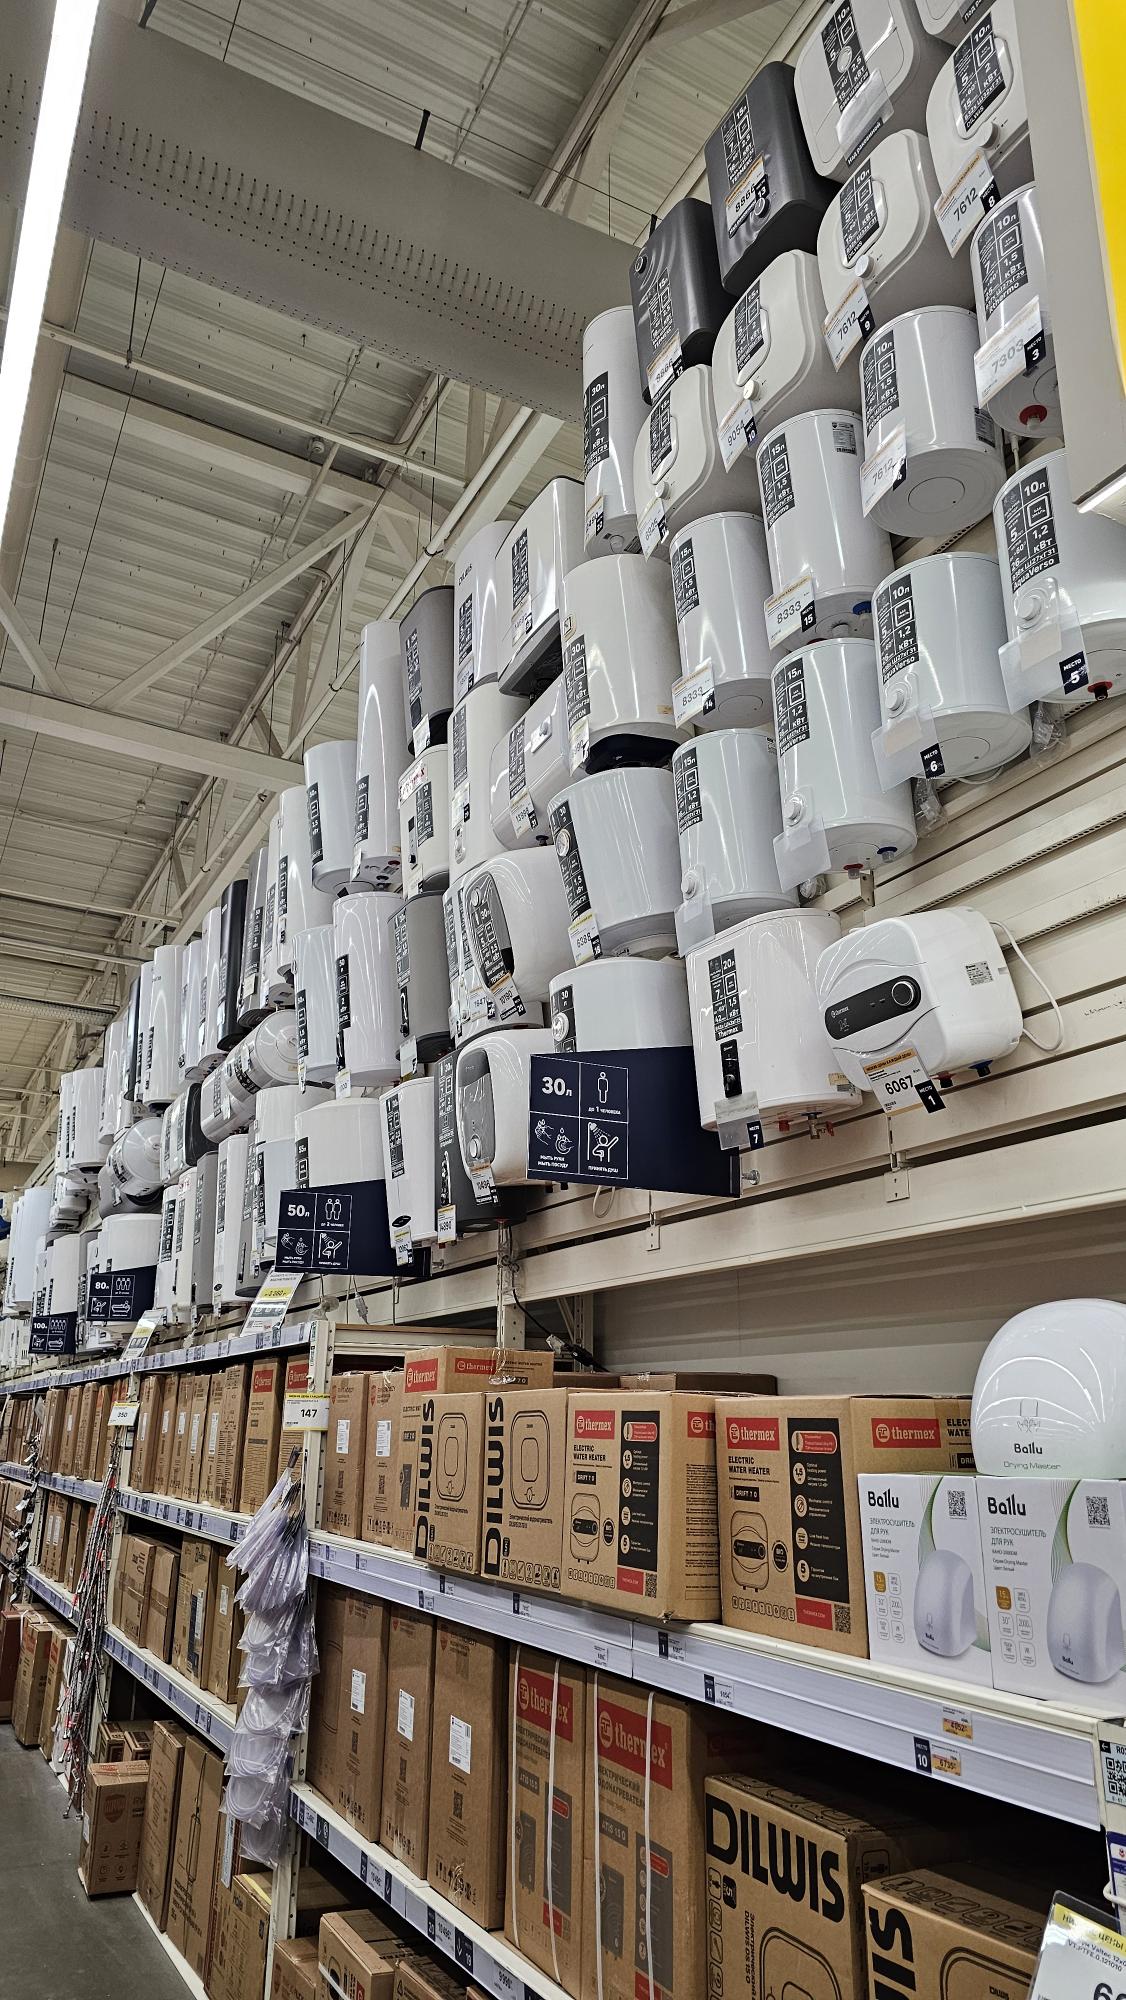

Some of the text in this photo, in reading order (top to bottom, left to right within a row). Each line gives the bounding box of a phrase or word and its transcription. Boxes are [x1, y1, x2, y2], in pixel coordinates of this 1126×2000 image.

[973, 24, 990, 42] 10л
[985, 62, 991, 73] 2
[961, 73, 968, 86] 5
[857, 169, 870, 185] 10л
[757, 187, 767, 199] 13
[953, 187, 978, 221] 7612
[988, 195, 995, 208] 8
[996, 213, 1017, 231] 10л
[1004, 251, 1018, 266] 1,5
[837, 311, 859, 341] 7612
[864, 321, 871, 331] 9
[876, 340, 893, 356] 10л
[1032, 348, 1040, 361] 3
[591, 383, 605, 397] 30л
[880, 377, 893, 390] 1,5
[595, 427, 601, 437] 2
[771, 443, 785, 454] 15л
[872, 458, 893, 486] 7612
[777, 479, 787, 490] 1,5
[1024, 481, 1046, 496] 10л
[1010, 529, 1018, 542] 5
[1033, 525, 1049, 540] 1,2
[1033, 538, 1053, 553] кВт
[680, 547, 692, 559] 15л
[1013, 557, 1055, 590] AquaVerso
[893, 586, 909, 600] 10л
[777, 601, 801, 624] 8333
[804, 615, 813, 626] 15
[898, 625, 912, 638] 1,2
[571, 644, 585, 656] 30л
[898, 639, 914, 651] кВт
[1063, 659, 1082, 671] МЕСТО
[787, 668, 802, 680] 15л
[1070, 670, 1080, 684] 5
[791, 705, 803, 717] 1,2
[792, 716, 806, 728] кВт
[683, 756, 696, 768] 15л
[930, 760, 938, 772] 6
[723, 959, 735, 970] 20л
[541, 1076, 573, 1097] 30л
[885, 1075, 913, 1095] 6067
[928, 1095, 936, 1106] 1
[753, 1134, 759, 1144] 7
[287, 1204, 310, 1217] 50л
[95, 1282, 109, 1290] 80л
[413, 1370, 436, 1384] thermex
[301, 1409, 318, 1418] 147
[585, 1418, 612, 1431] thermex
[946, 1419, 971, 1427] ELECT
[741, 1427, 775, 1441] thermex
[889, 1428, 935, 1440] thermex
[947, 1430, 971, 1438] WATE
[1014, 1442, 1043, 1455] Ballu
[573, 1453, 606, 1462] WATER HEATER
[728, 1456, 754, 1464] ELECTRIC
[728, 1466, 770, 1475] WATER HEATER
[1003, 1461, 1061, 1470] Drying Master
[415, 1399, 435, 1559] DILWIS
[484, 1396, 504, 1576] DILWIS
[735, 1489, 748, 1497] DRIFT
[868, 1488, 899, 1508] Ballu
[987, 1494, 1027, 1516] Ballu
[869, 1517, 916, 1529] ЭЛЕКТРОСУШИТЕЛЬ
[990, 1526, 1046, 1538] ЭЛЕКТРОСУШИТЕЛЬ
[623, 1537, 628, 1546] 5
[991, 1538, 1014, 1546] ДЛЯ РУК
[800, 1563, 806, 1573] 5
[917, 1753, 928, 1768] 10
[706, 1793, 845, 1923] DILWIS
[1091, 1945, 1112, 1959] Valtec
[465, 1953, 472, 1967] 19
